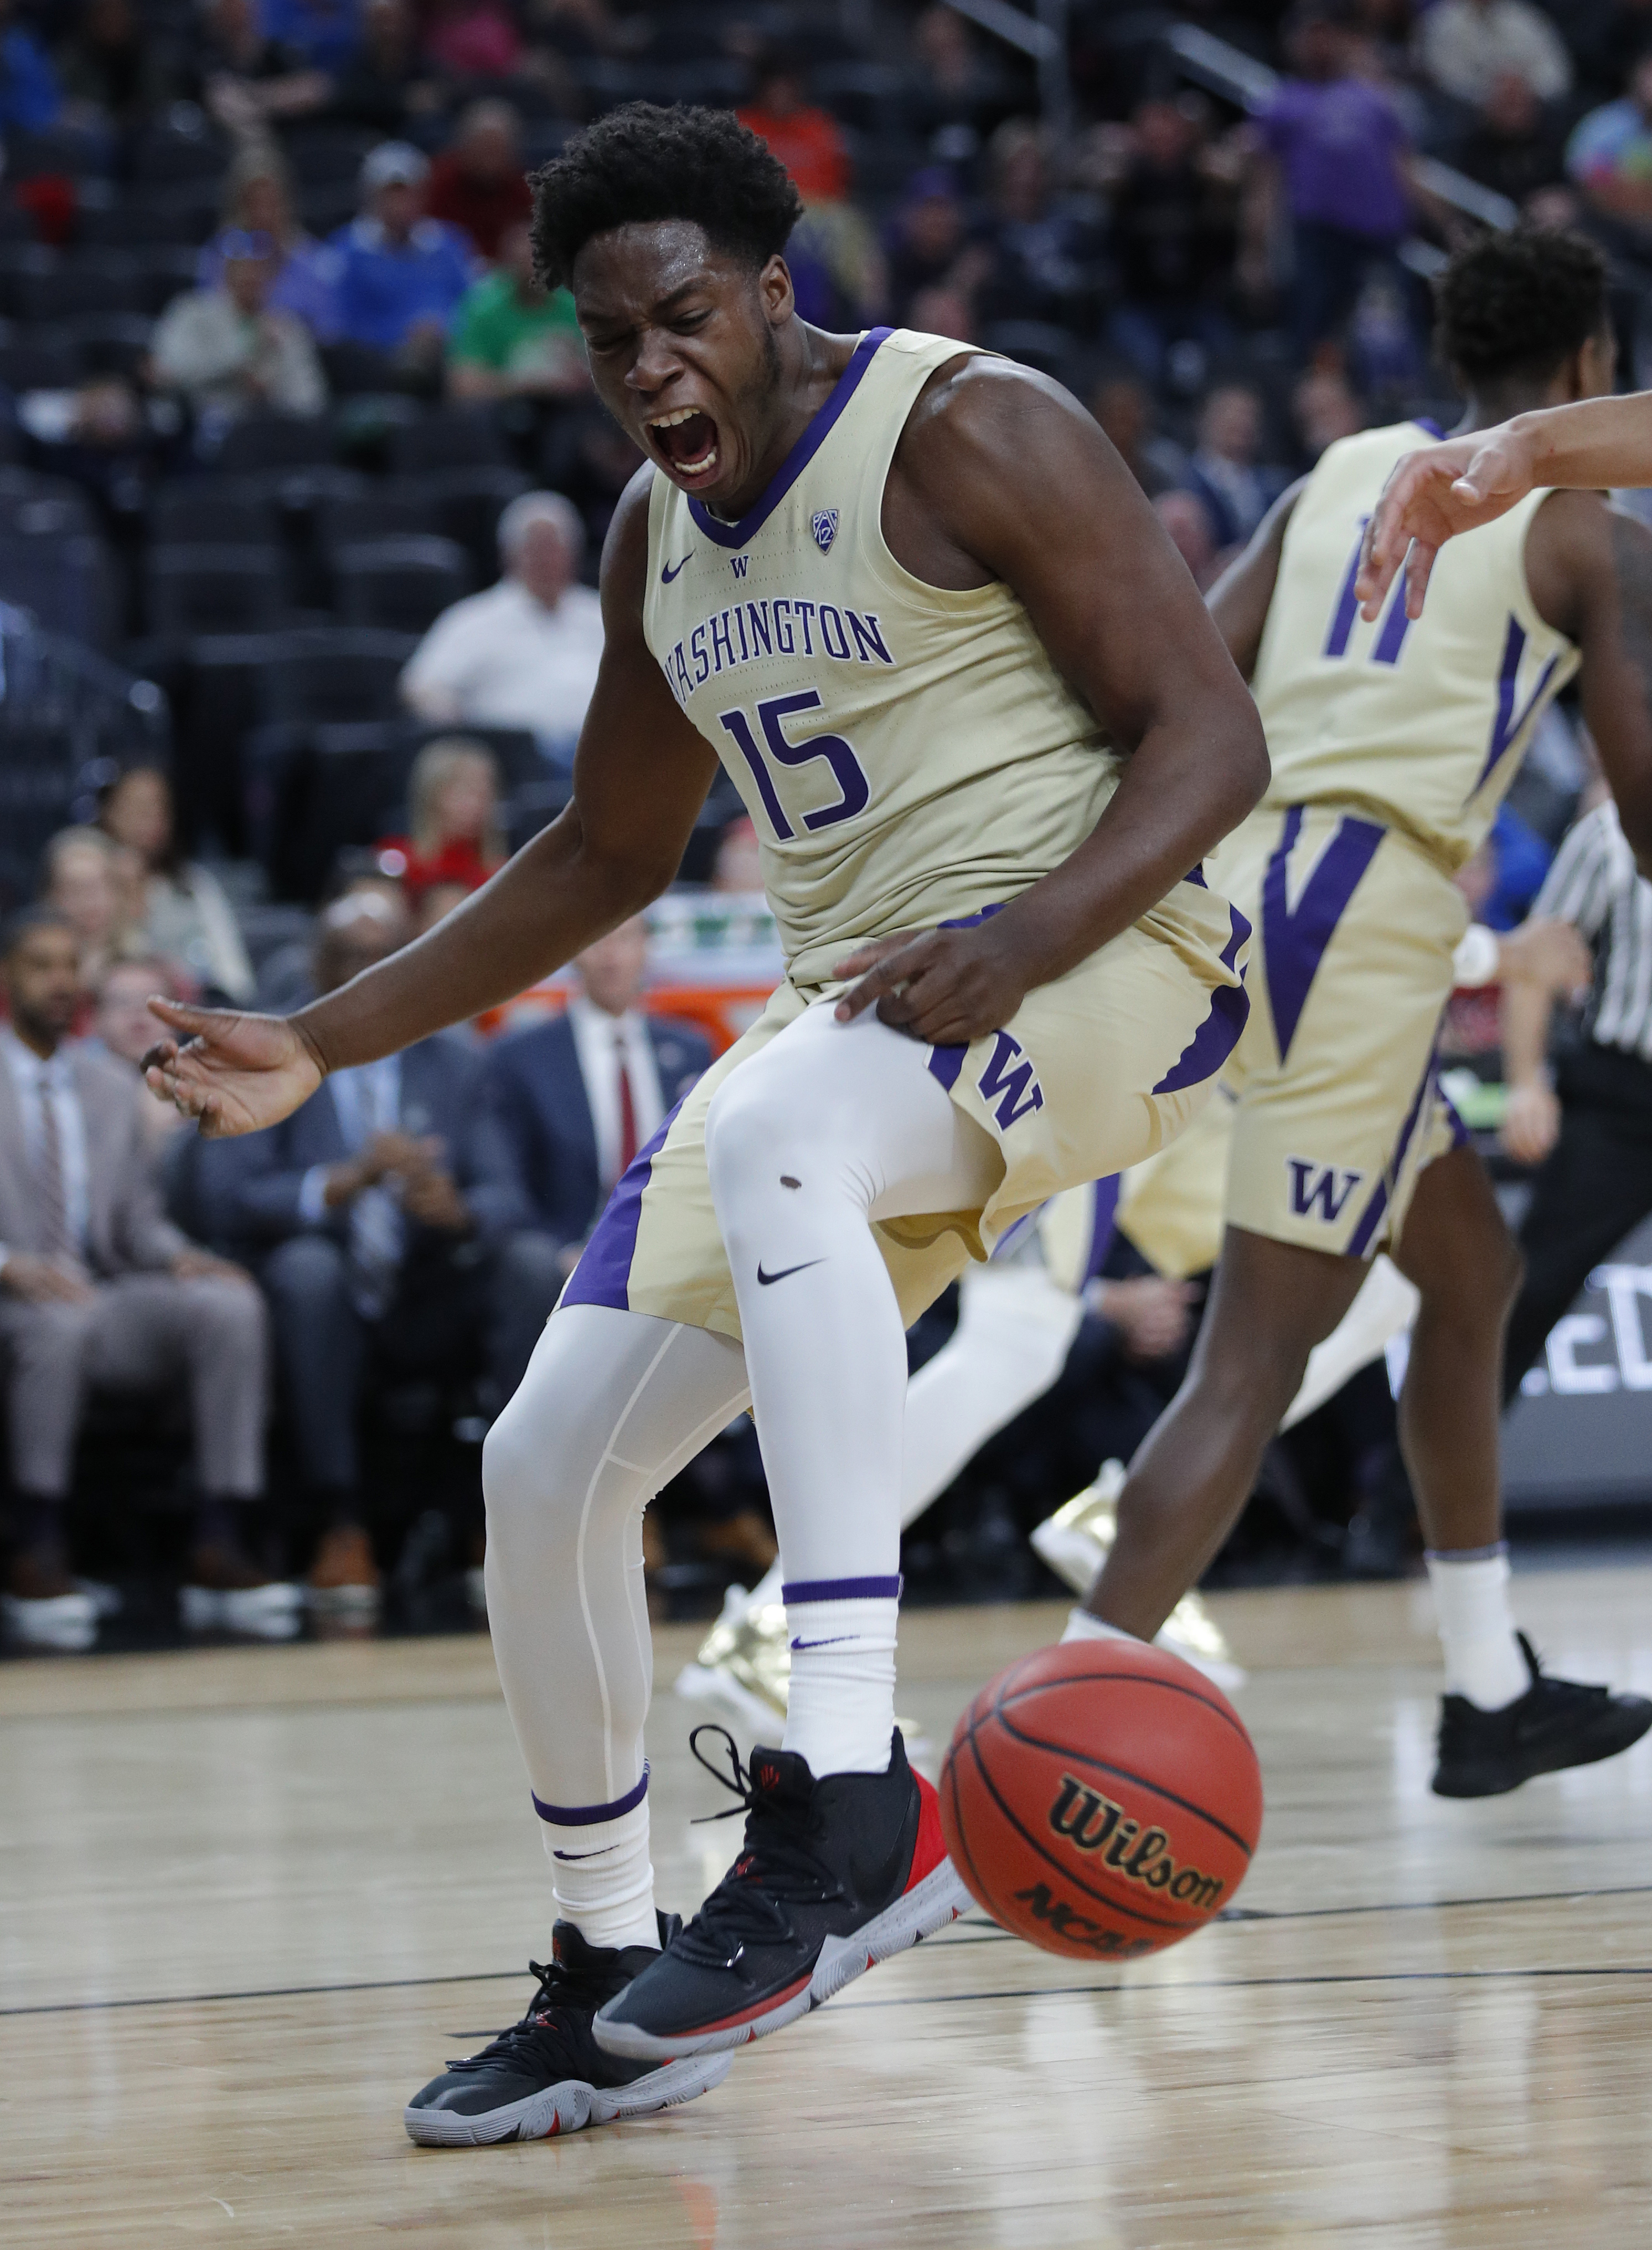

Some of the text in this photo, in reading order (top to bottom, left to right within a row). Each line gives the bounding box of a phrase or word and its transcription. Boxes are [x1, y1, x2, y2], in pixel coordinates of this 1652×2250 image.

[812, 510, 838, 539] PAC
[819, 527, 831, 545] 12
[730, 555, 748, 578] W
[717, 687, 871, 844] 15
[976, 1029, 1045, 1134] W
[1286, 1156, 1361, 1221] W
[1049, 1773, 1225, 1908] Wilson
